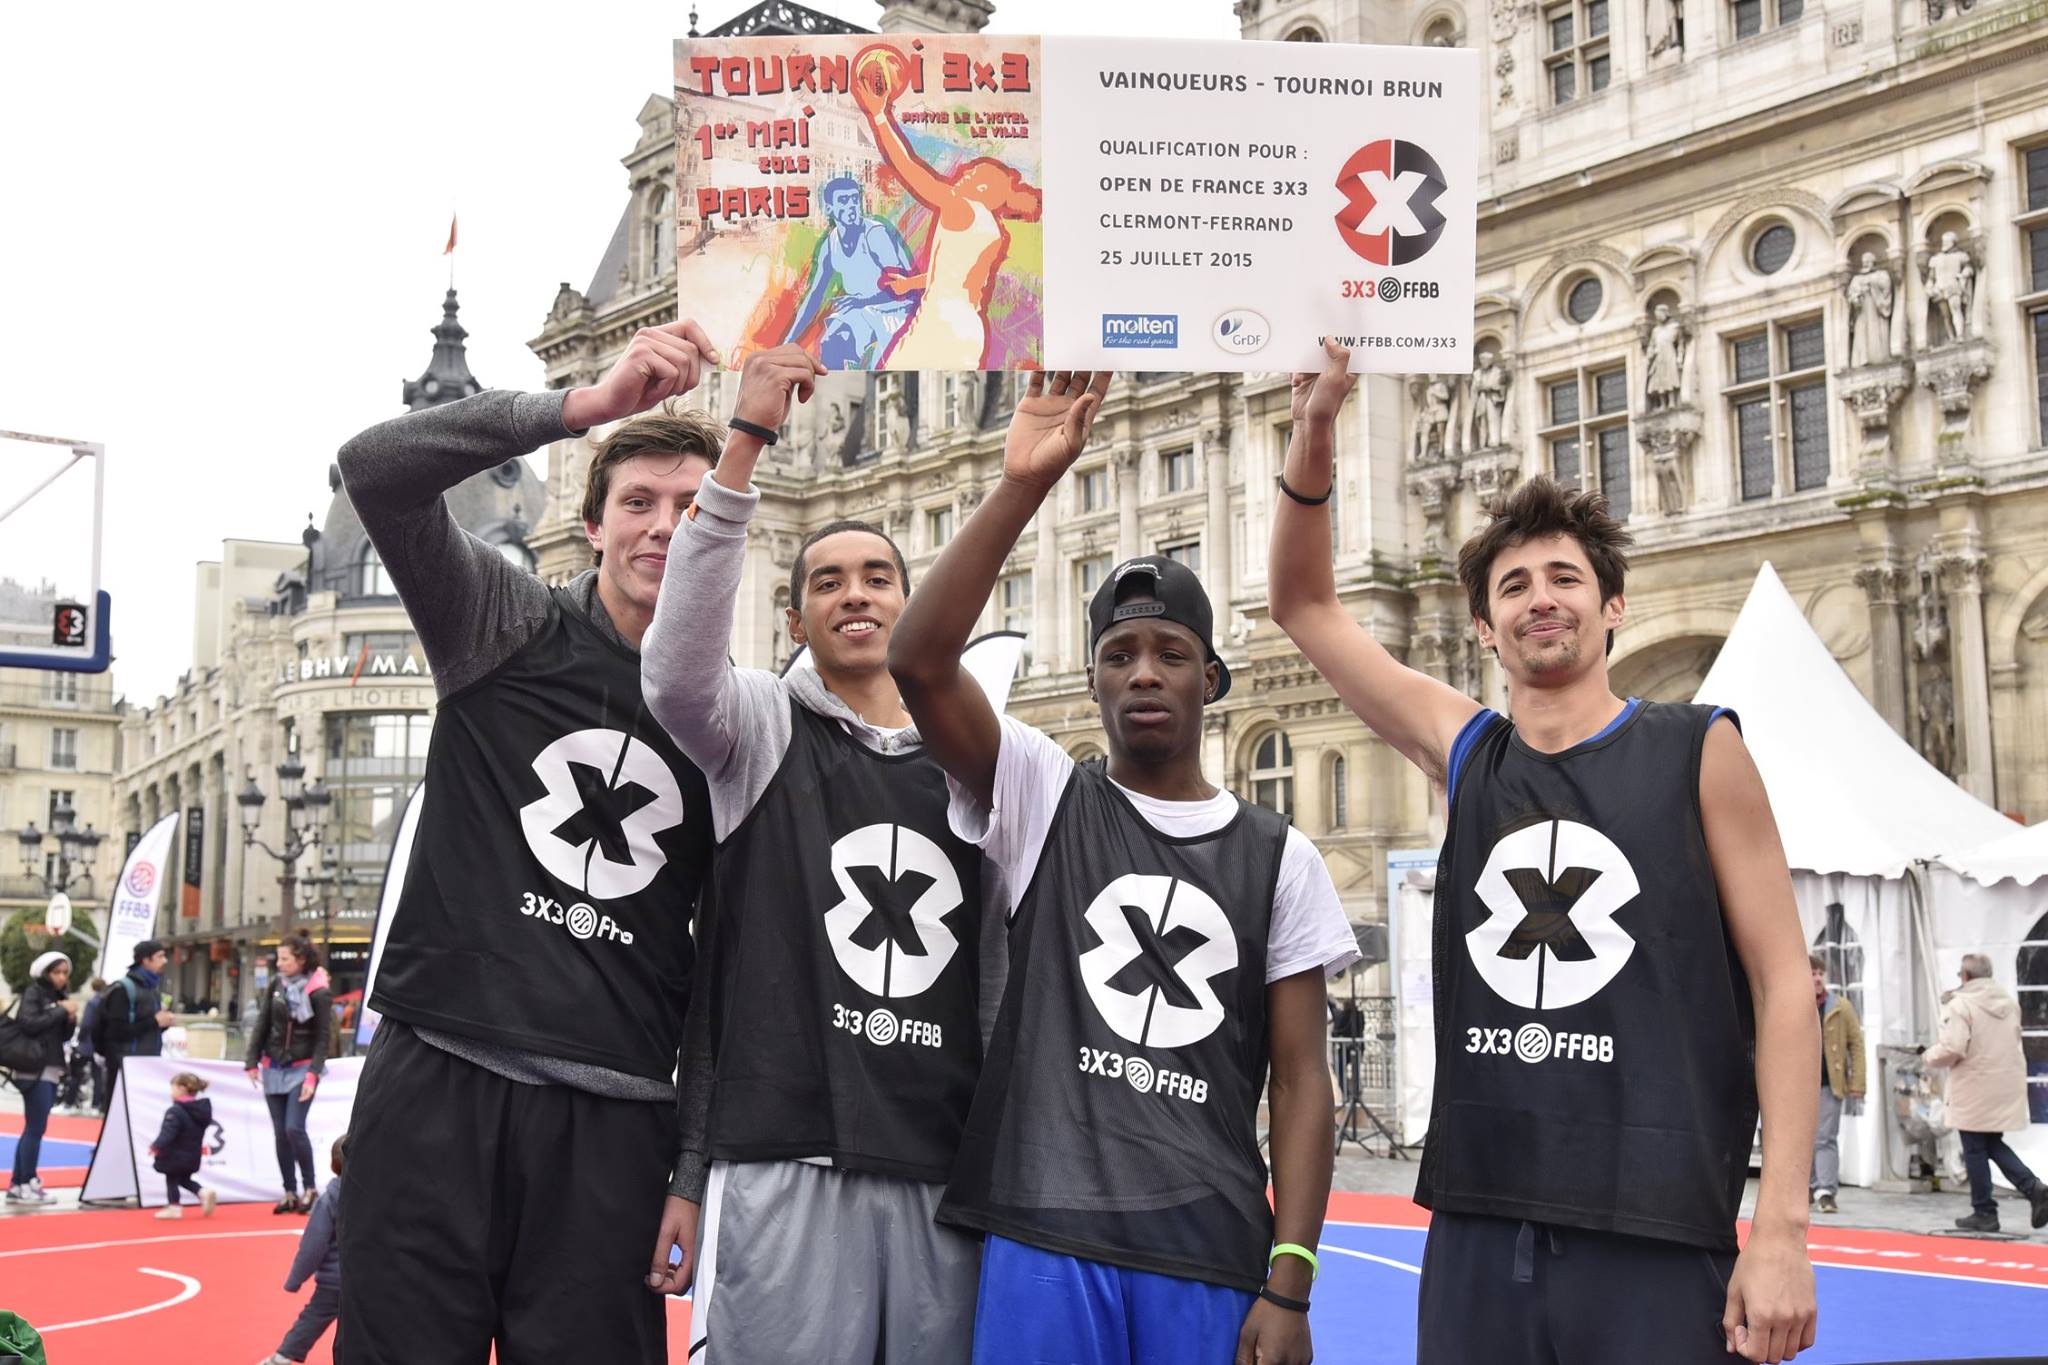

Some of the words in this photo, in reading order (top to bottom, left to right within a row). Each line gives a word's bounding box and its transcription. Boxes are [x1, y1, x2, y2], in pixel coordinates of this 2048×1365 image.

[1099, 71, 1248, 93] VAINQUEURS
[1274, 76, 1374, 97] TOURNOI
[1383, 80, 1443, 99] BRUN
[991, 126, 1029, 139] VILLE
[1099, 140, 1240, 158] QUALIFICATION
[1248, 143, 1297, 159] POUR
[758, 155, 810, 174] 2015
[1099, 176, 1152, 193] OPEN
[1160, 178, 1184, 193] DE
[1192, 179, 1265, 195] FRANCE
[1272, 181, 1308, 196] 3X3
[696, 186, 811, 220] PARIS
[1099, 213, 1293, 232] CLERMONT-FERRAND
[1099, 250, 1123, 266] 25
[1129, 251, 1203, 267] JUILLET
[1210, 252, 1253, 267] 2015
[1341, 280, 1376, 298] 3X3
[1402, 281, 1440, 299] FFBB
[1106, 317, 1174, 334] molten
[1232, 335, 1262, 346] GrDF
[301, 655, 349, 680] BHV
[371, 654, 432, 675] MA
[118, 900, 151, 919] FFBB
[519, 891, 565, 925] 3X3
[900, 1018, 943, 1049] FFBB
[1464, 1026, 1512, 1055] 3X3
[1553, 1032, 1615, 1063] FFBB
[1078, 1046, 1124, 1079] 3X3
[1155, 1069, 1208, 1104] FFBB
